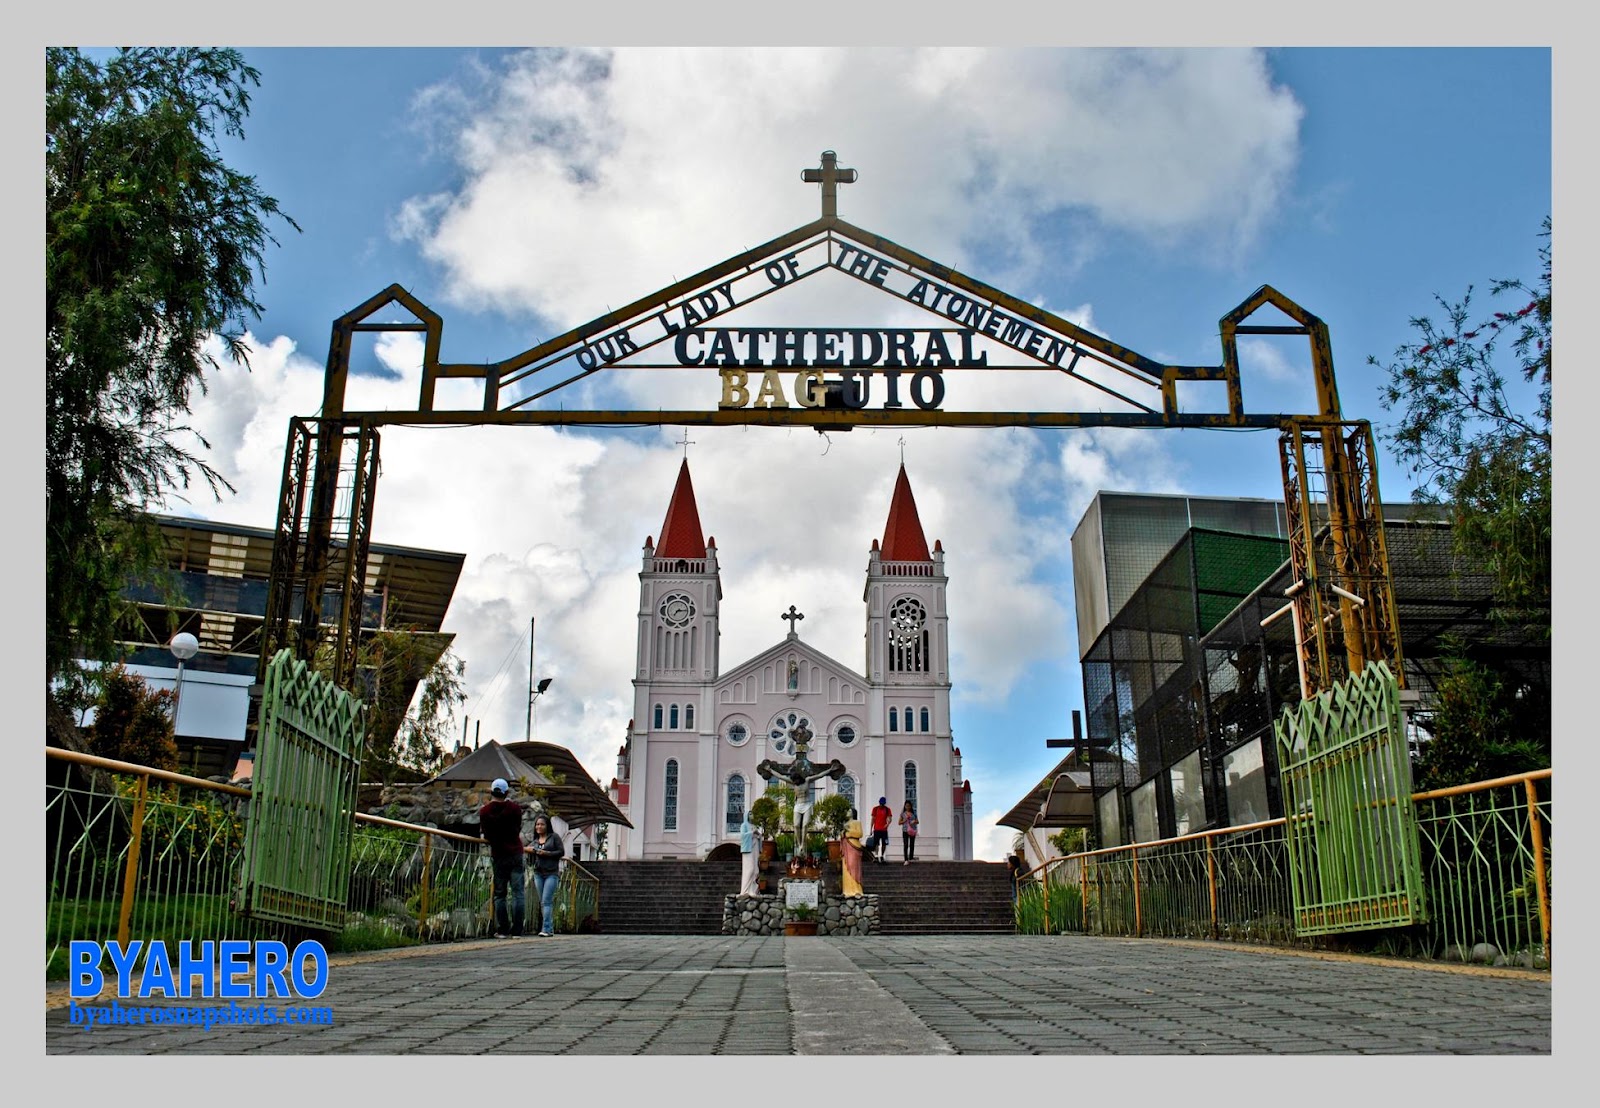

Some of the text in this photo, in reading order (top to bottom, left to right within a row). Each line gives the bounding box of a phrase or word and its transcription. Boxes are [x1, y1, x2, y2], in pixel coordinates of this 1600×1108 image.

[576, 243, 1088, 372] OUR LADY OF THE ATONEMENT
[675, 328, 987, 366] CATHEDRAL
[718, 368, 945, 410] BAGUIO
